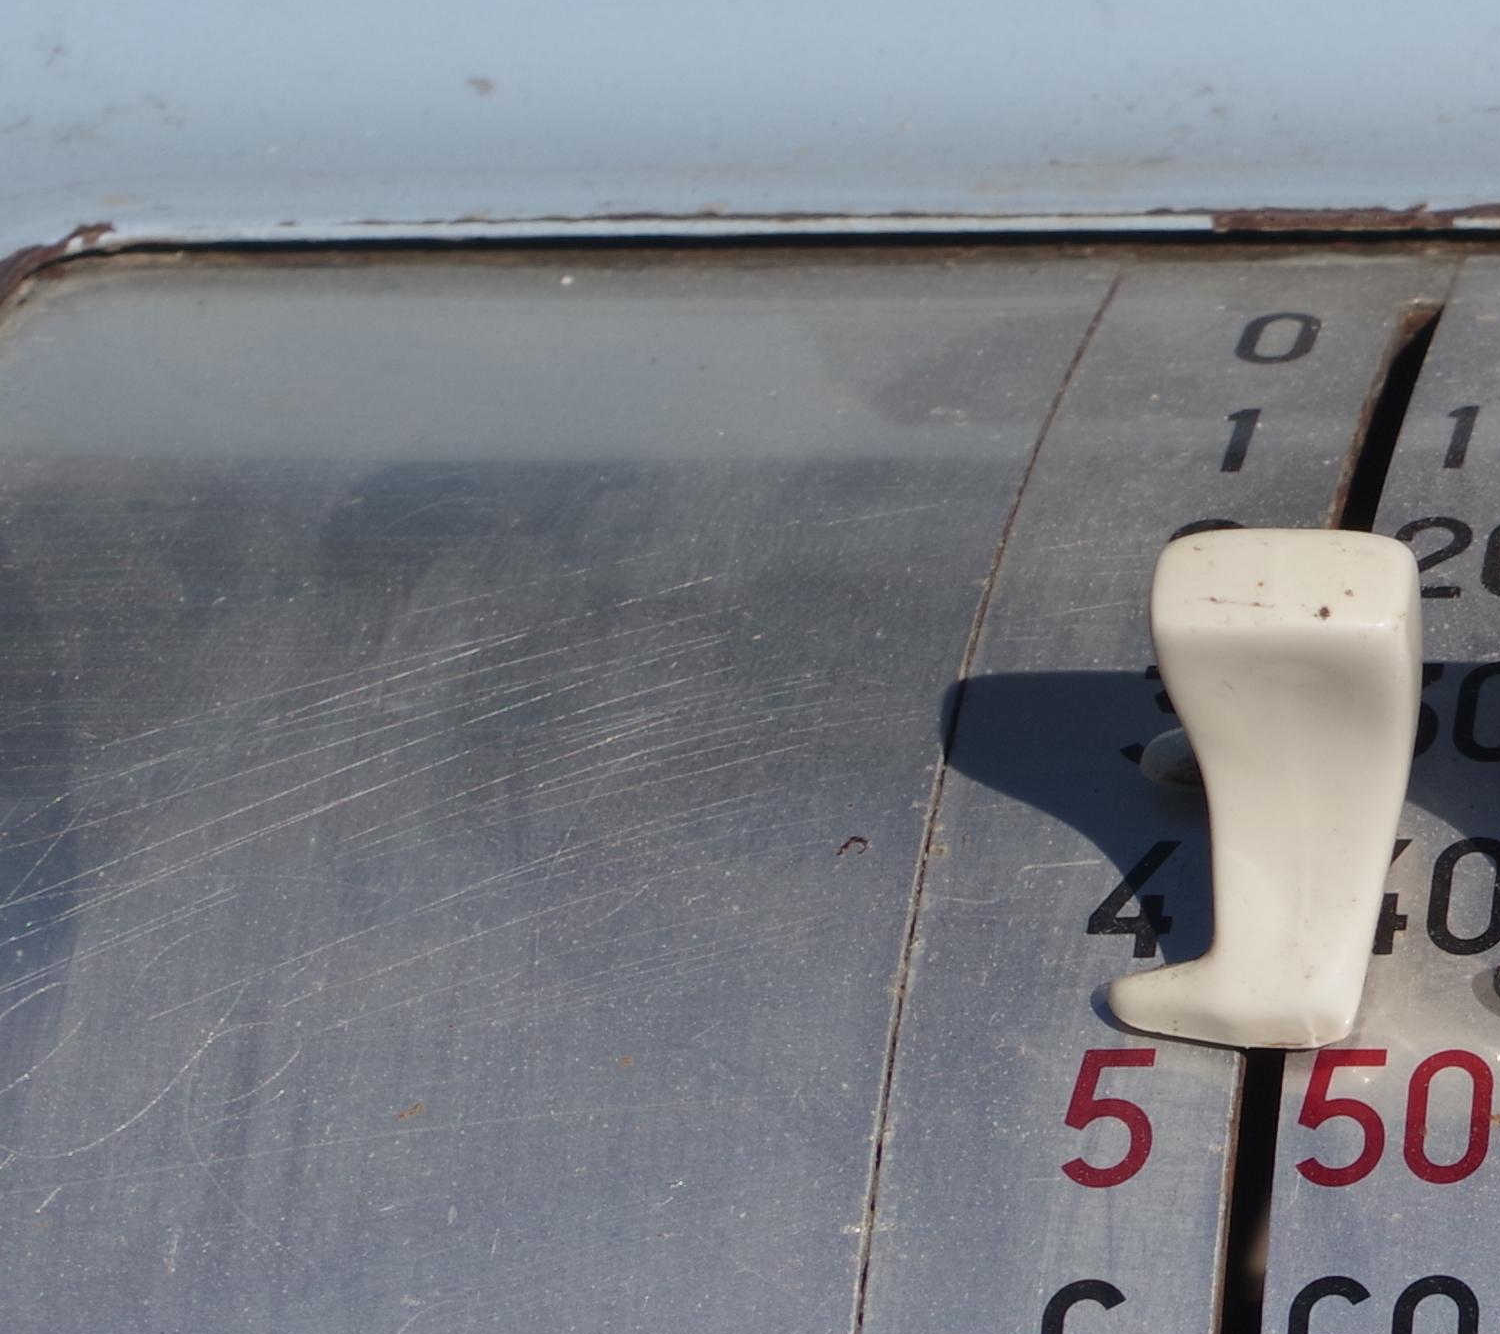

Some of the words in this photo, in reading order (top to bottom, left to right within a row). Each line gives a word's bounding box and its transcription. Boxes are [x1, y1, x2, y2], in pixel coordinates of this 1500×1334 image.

[1235, 313, 1321, 364] 0
[1220, 409, 1261, 473] 1
[1087, 840, 1176, 961] 4
[1064, 1048, 1157, 1187] 5
